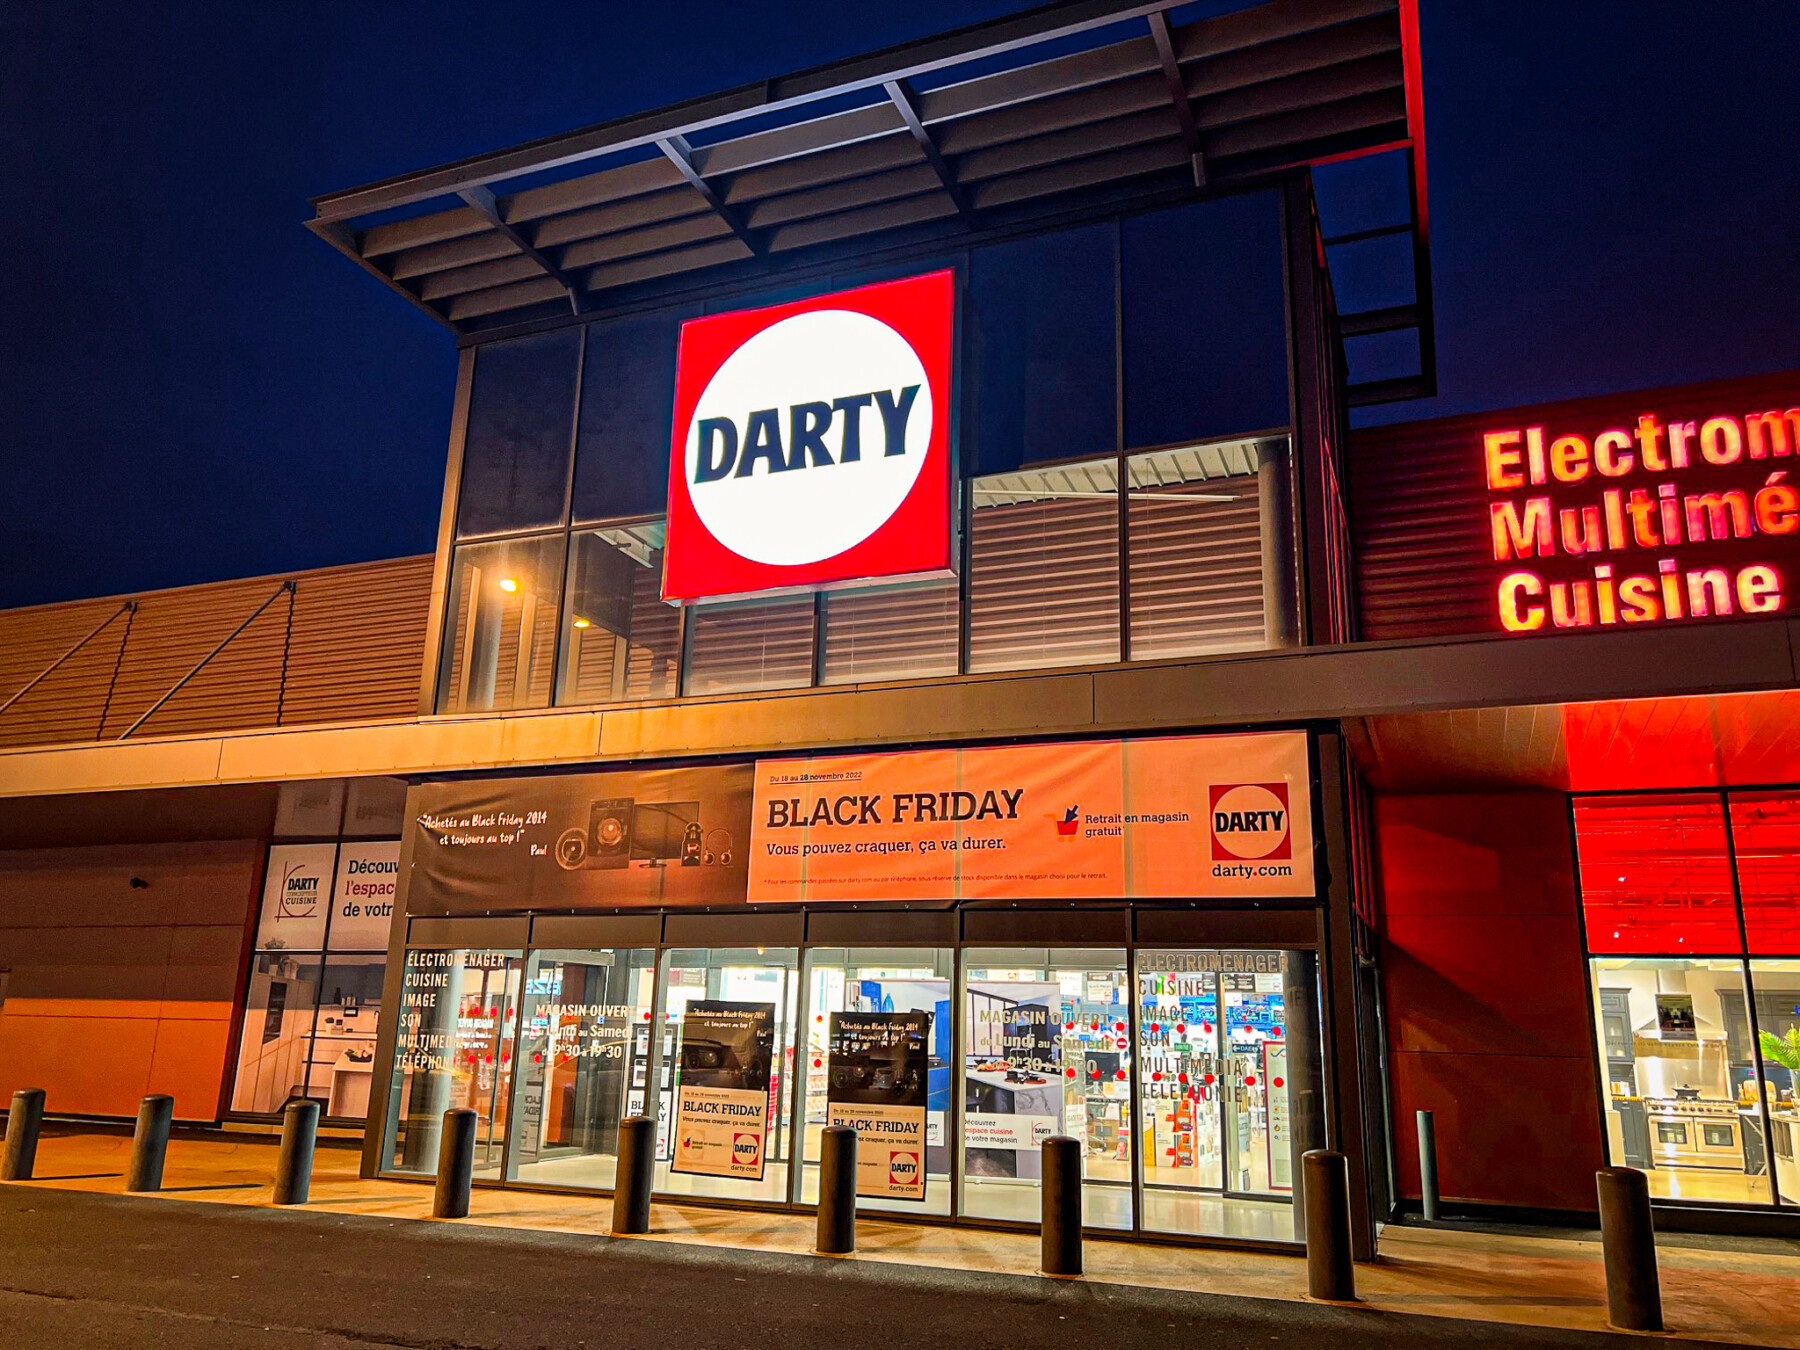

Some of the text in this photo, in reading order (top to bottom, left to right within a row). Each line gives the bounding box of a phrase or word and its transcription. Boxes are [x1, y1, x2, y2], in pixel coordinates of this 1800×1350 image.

[694, 384, 921, 484] DARTY
[1484, 408, 1800, 490] Electrom
[1490, 472, 1799, 561] Multimé
[1498, 559, 1781, 632] Cuisine
[767, 789, 1024, 827] BLACK FRIDAY
[460, 818, 469, 827] au
[472, 814, 495, 827] Black
[498, 812, 523, 828] Friday
[526, 811, 547, 825] 2014
[1085, 812, 1189, 824] Retrait en magasin
[1215, 810, 1284, 833] DARTY
[440, 834, 449, 845] et
[451, 833, 485, 846] toujours
[486, 835, 497, 844] au
[500, 833, 515, 845] top
[766, 836, 1006, 857] Vous pouvez craquer, ça va durer.
[530, 844, 547, 856] Paul
[348, 859, 399, 874] Découv
[1212, 864, 1292, 880] darty.com
[287, 877, 319, 890] DARTY
[285, 897, 317, 905] CUISINE
[343, 902, 393, 917] de votr
[405, 973, 449, 987] CUISINE
[1139, 979, 1204, 996] CUISINE
[403, 993, 437, 1007] IMAGE
[590, 1004, 630, 1018] OUVER
[980, 1009, 1109, 1026] MAGASIN OUVERT
[1140, 1005, 1188, 1022] IMAGE
[400, 1014, 421, 1028] SON
[578, 1029, 588, 1037] au
[1140, 1030, 1170, 1047] SON
[995, 1033, 1035, 1048] Lundi
[1038, 1040, 1050, 1049] au
[554, 1044, 580, 1057] 9h30
[589, 1045, 622, 1058] 19h30
[1007, 1056, 1042, 1072] 9h30
[1140, 1057, 1243, 1076] MULTIMEDIA
[1141, 1082, 1243, 1103] TELEPHONIE
[631, 1101, 665, 1110] BLK
[683, 1100, 762, 1117] BLACK FRIDAY
[875, 1120, 919, 1134] FRIDAY
[990, 1136, 1018, 1144] magasin
[734, 1144, 758, 1154] DARTY
[731, 1165, 757, 1173] darty.com
[891, 1163, 917, 1174] DARTY
[889, 1185, 918, 1193] darty.com
